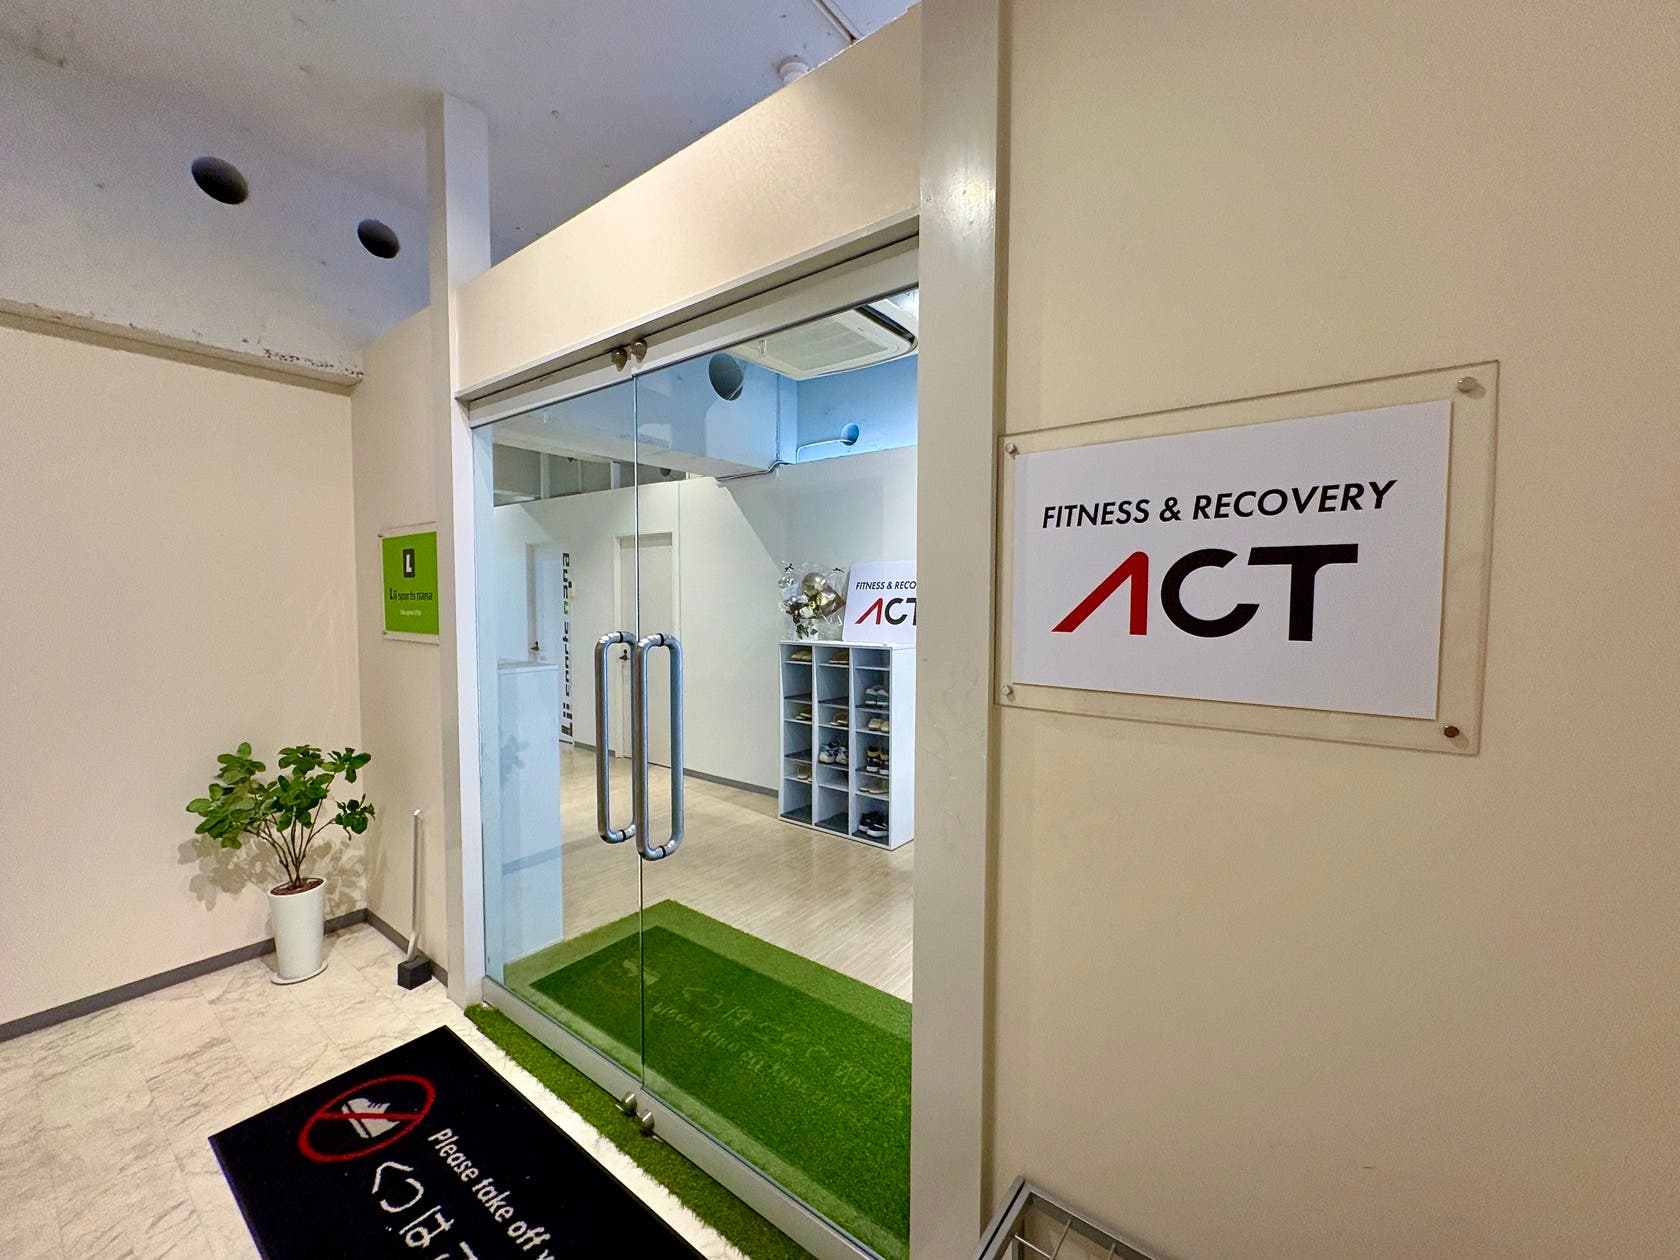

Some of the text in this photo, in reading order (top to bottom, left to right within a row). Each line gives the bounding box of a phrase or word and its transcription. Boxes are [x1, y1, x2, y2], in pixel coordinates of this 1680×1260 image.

[1042, 479, 1398, 529] FITNESS & RECOVERY
[855, 581, 885, 590] FITNESS
[886, 581, 893, 590] &
[1051, 543, 1359, 642] ACT
[427, 1128, 479, 1182] Please
[472, 1178, 514, 1223] take
[507, 1220, 551, 1252] off
